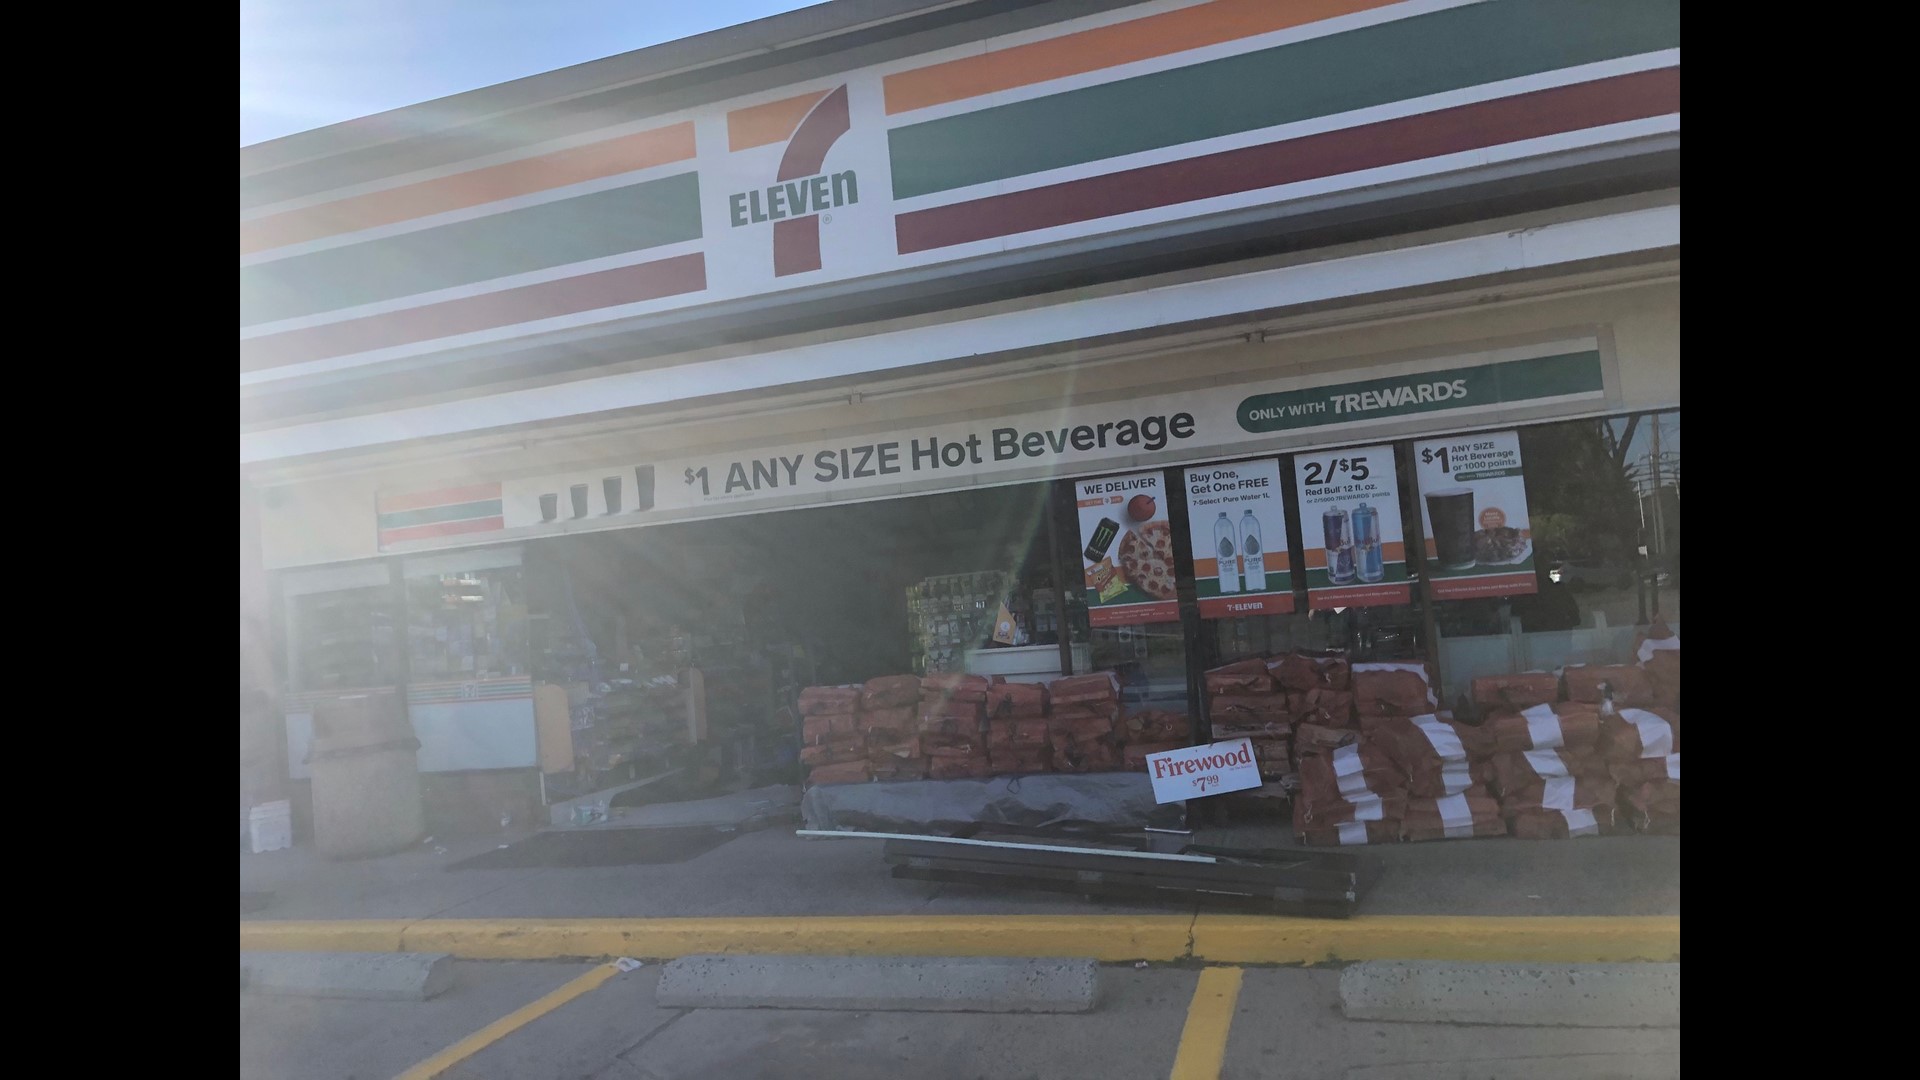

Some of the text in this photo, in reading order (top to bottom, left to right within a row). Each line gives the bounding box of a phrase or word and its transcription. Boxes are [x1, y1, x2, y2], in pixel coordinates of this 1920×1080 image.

[727, 83, 851, 278] 7
[1249, 379, 1468, 422] ONLY WITH 7REWARDS
[684, 411, 1196, 496] $1 ANY SIZE Hot Beverage
[1451, 442, 1495, 453] ANY SIZE
[1421, 447, 1450, 474] $1
[1451, 450, 1514, 463] Hot Beverage
[1464, 461, 1486, 470] 1000
[1487, 459, 1517, 469] points
[1190, 471, 1239, 483] Buy One,
[1303, 457, 1370, 486] 2/$5
[1084, 478, 1156, 495] WE DELIVER
[1191, 477, 1269, 494] Get One FREE
[1305, 487, 1322, 496] Red
[1324, 486, 1340, 495] Bull
[1355, 484, 1364, 492] fl.
[1193, 497, 1221, 506] 7-Select
[1153, 742, 1252, 779] Firewood
